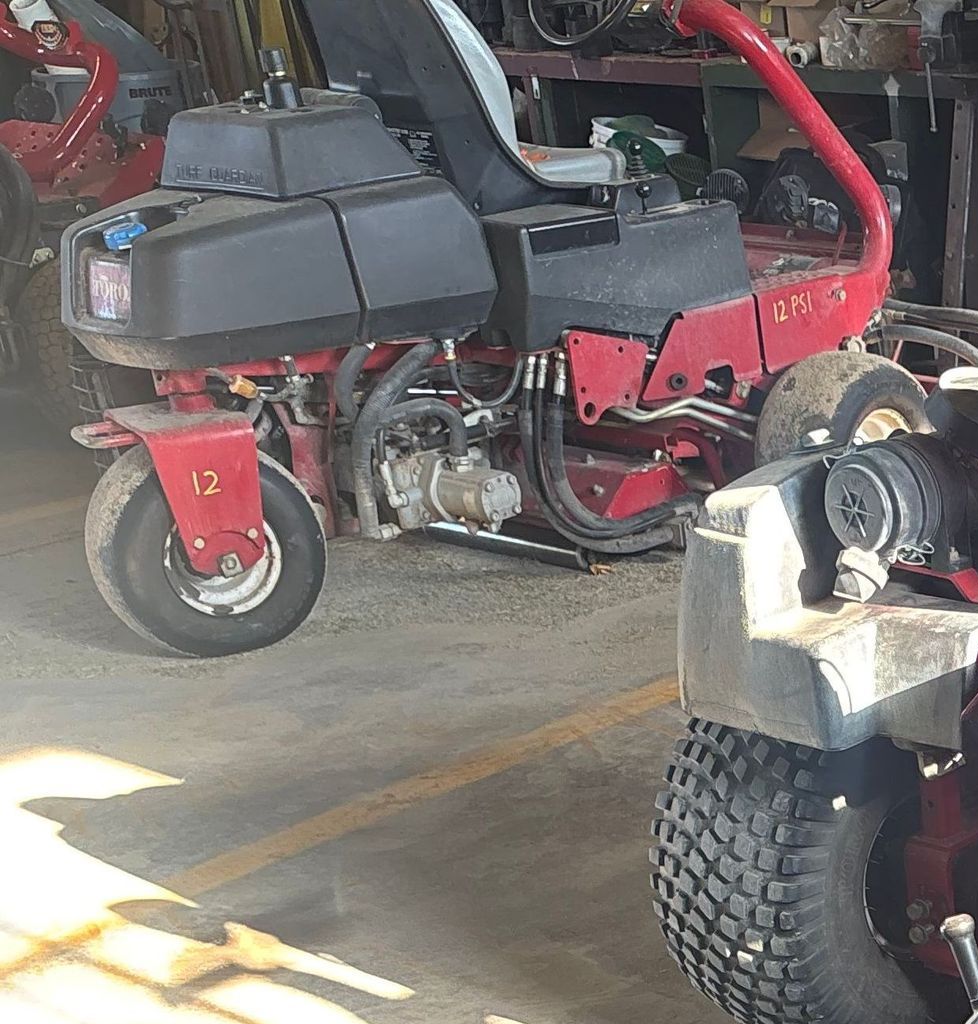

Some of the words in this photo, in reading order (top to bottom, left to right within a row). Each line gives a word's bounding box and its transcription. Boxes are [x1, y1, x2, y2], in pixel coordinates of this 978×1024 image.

[129, 86, 172, 98] BRUTE
[772, 299, 789, 324] 12
[790, 290, 813, 317] PSI
[192, 470, 222, 496] 12
